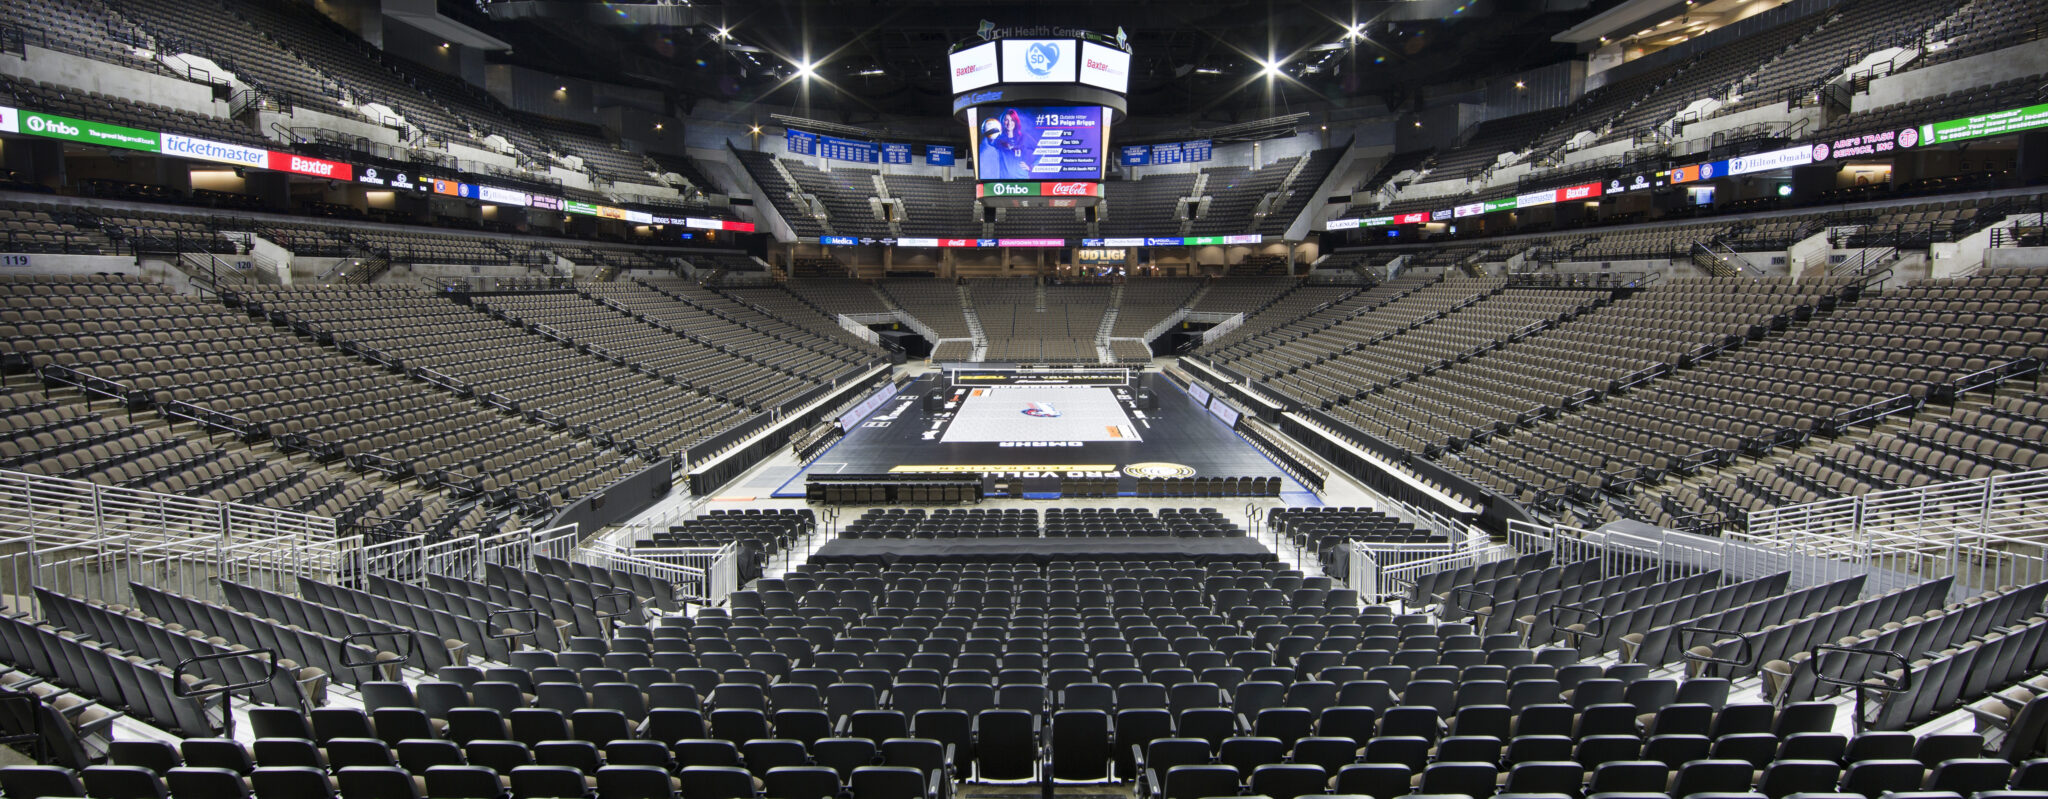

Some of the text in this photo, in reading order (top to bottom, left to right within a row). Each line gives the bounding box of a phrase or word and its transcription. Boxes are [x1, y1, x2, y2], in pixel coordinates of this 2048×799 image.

[1015, 26, 1050, 37] Health
[1052, 26, 1086, 39] Center
[1031, 54, 1044, 64] SD
[1087, 58, 1108, 72] Baxter
[956, 65, 976, 76] Baxter
[1036, 114, 1058, 126] #13
[46, 120, 79, 136] fnbo
[1833, 136, 1861, 149] ABE'S
[1862, 131, 1895, 144] TRASH
[167, 136, 263, 164] ticketmaster
[1833, 144, 1875, 158] SERVICE,
[1877, 141, 1894, 152] INC
[1750, 155, 1776, 168] Hilton
[1779, 151, 1811, 163] Omaha
[291, 157, 333, 176] Baxter
[1006, 184, 1029, 194] fnbo
[1566, 186, 1590, 199] Baxter
[1519, 193, 1553, 205] ticketmaster
[832, 237, 853, 245] Medica
[3, 256, 28, 266] 119
[236, 259, 252, 270] 120
[1773, 256, 1785, 264] 106
[1066, 470, 1121, 478] PRO
